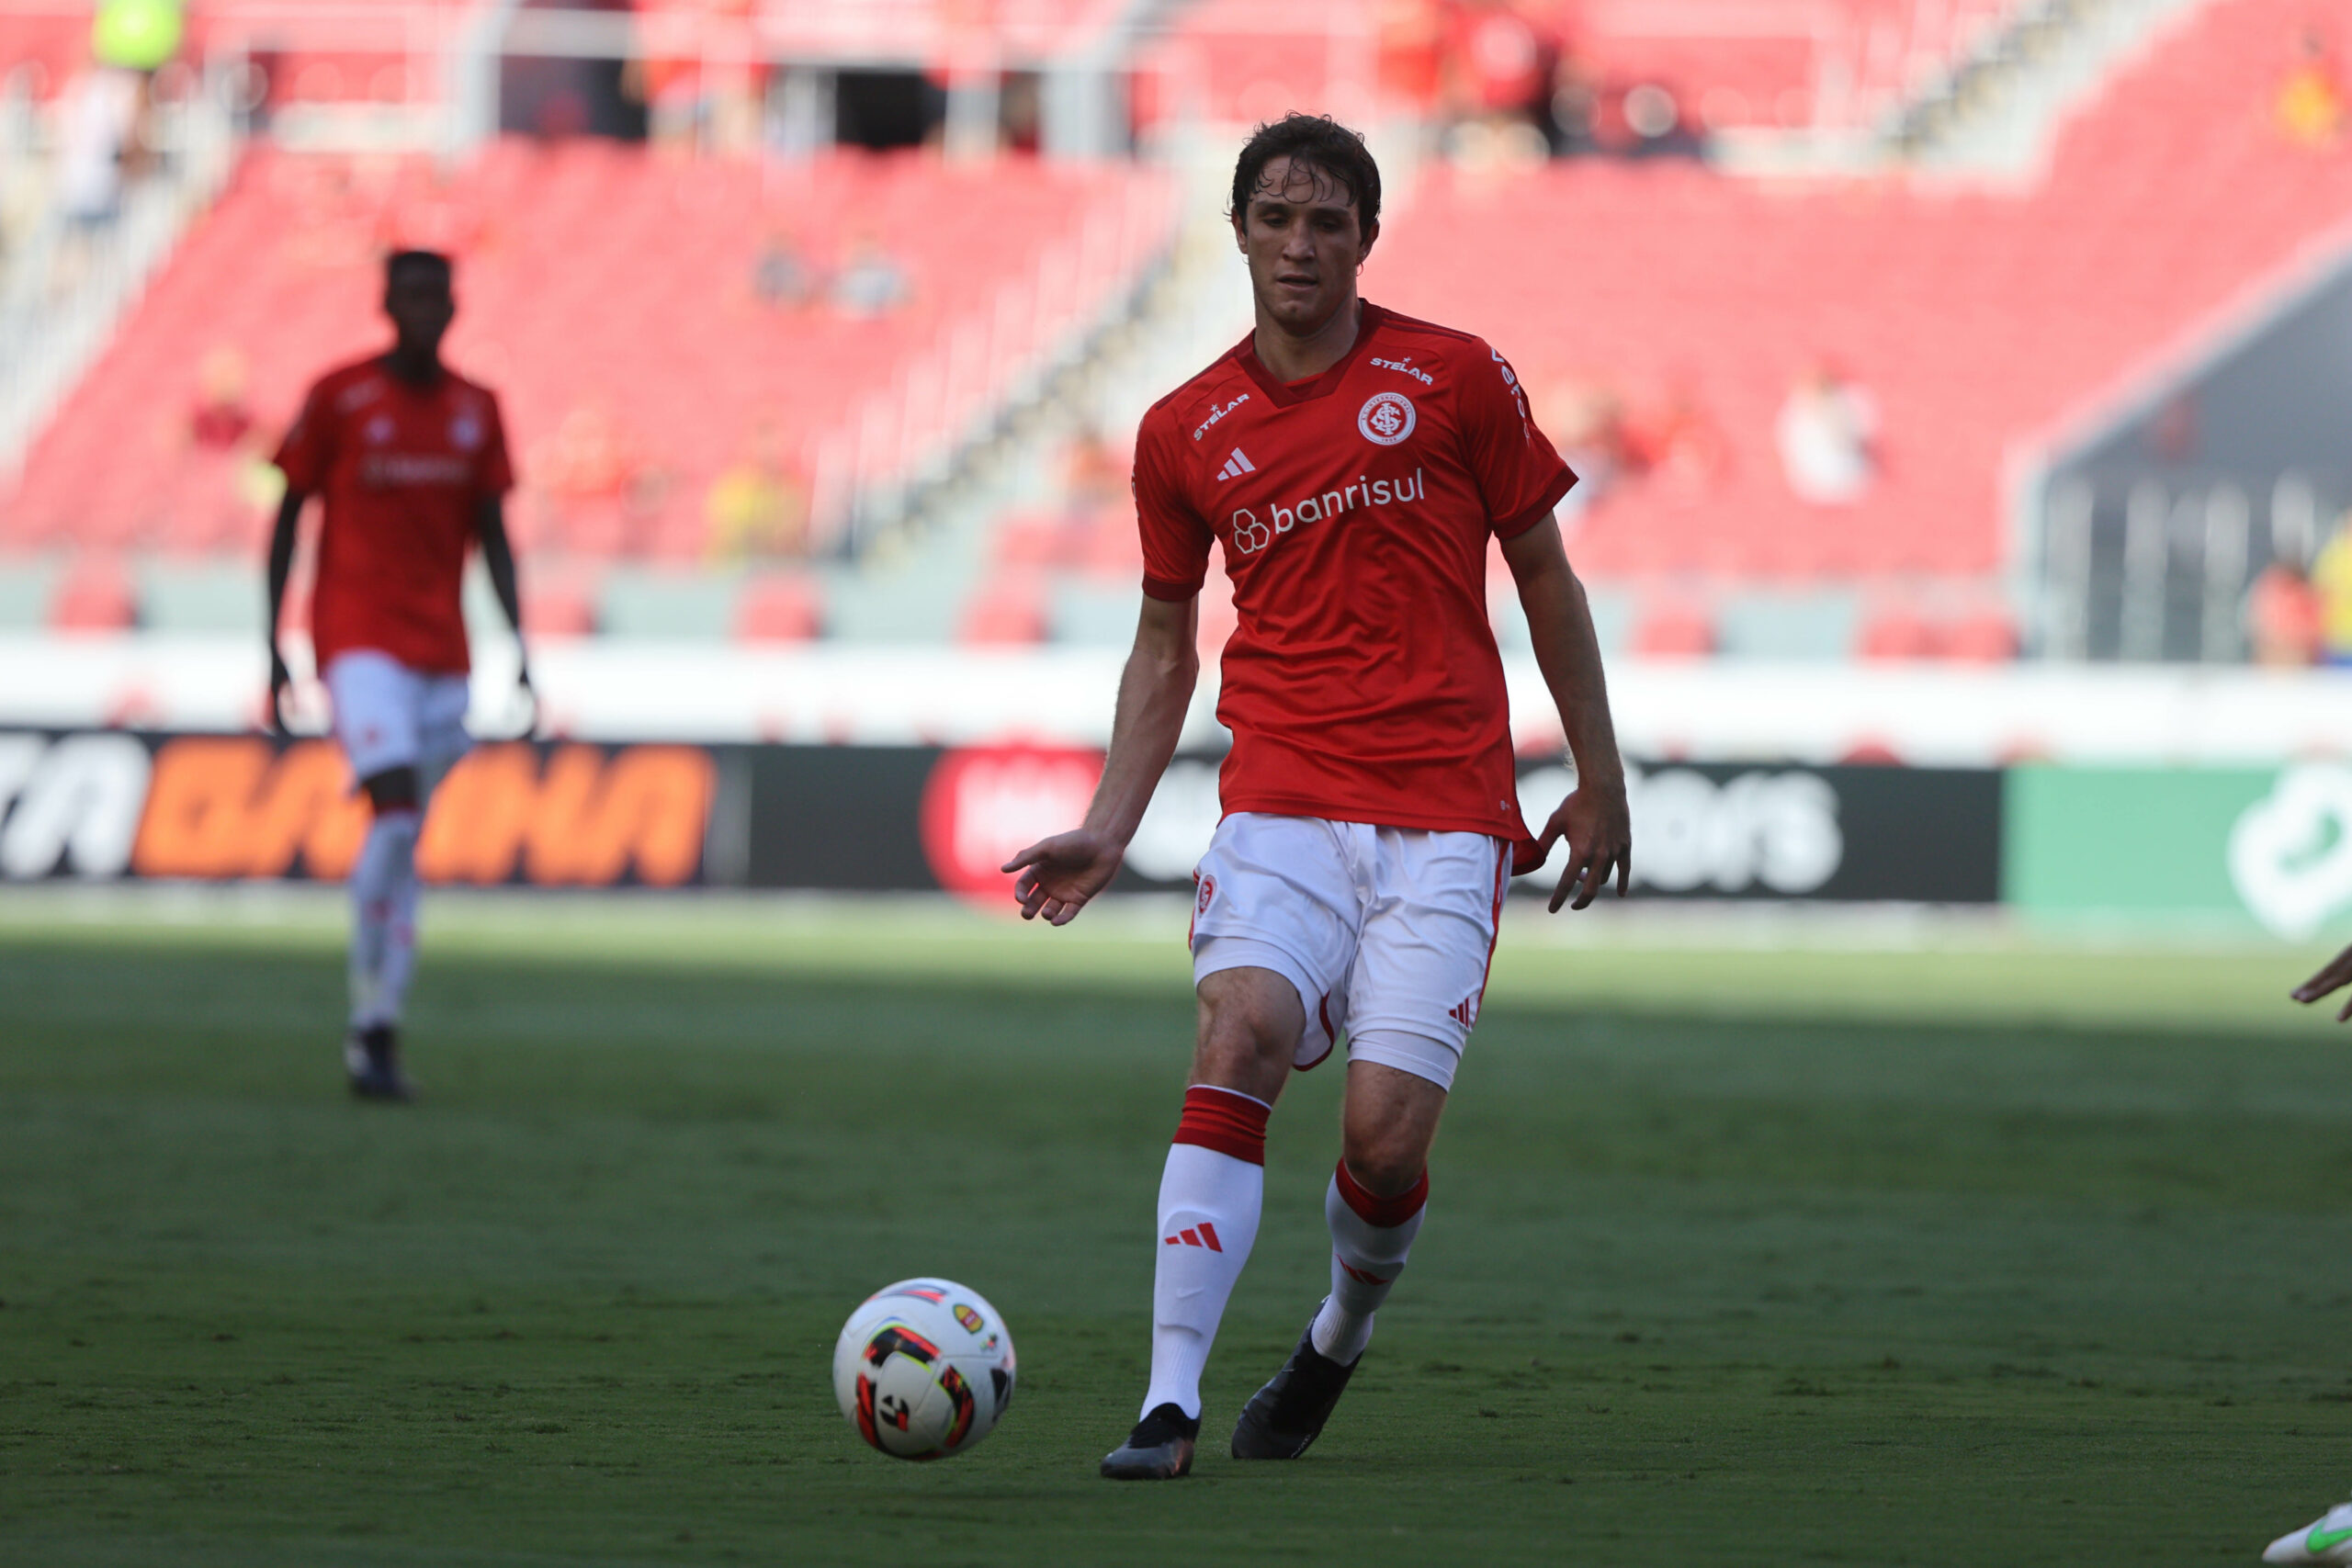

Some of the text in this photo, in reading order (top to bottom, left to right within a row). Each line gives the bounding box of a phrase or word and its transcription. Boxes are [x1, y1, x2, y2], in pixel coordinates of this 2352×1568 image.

[1369, 356, 1433, 386] STELAR
[1193, 393, 1250, 441] STELAR
[1270, 467, 1425, 535] banrisul
